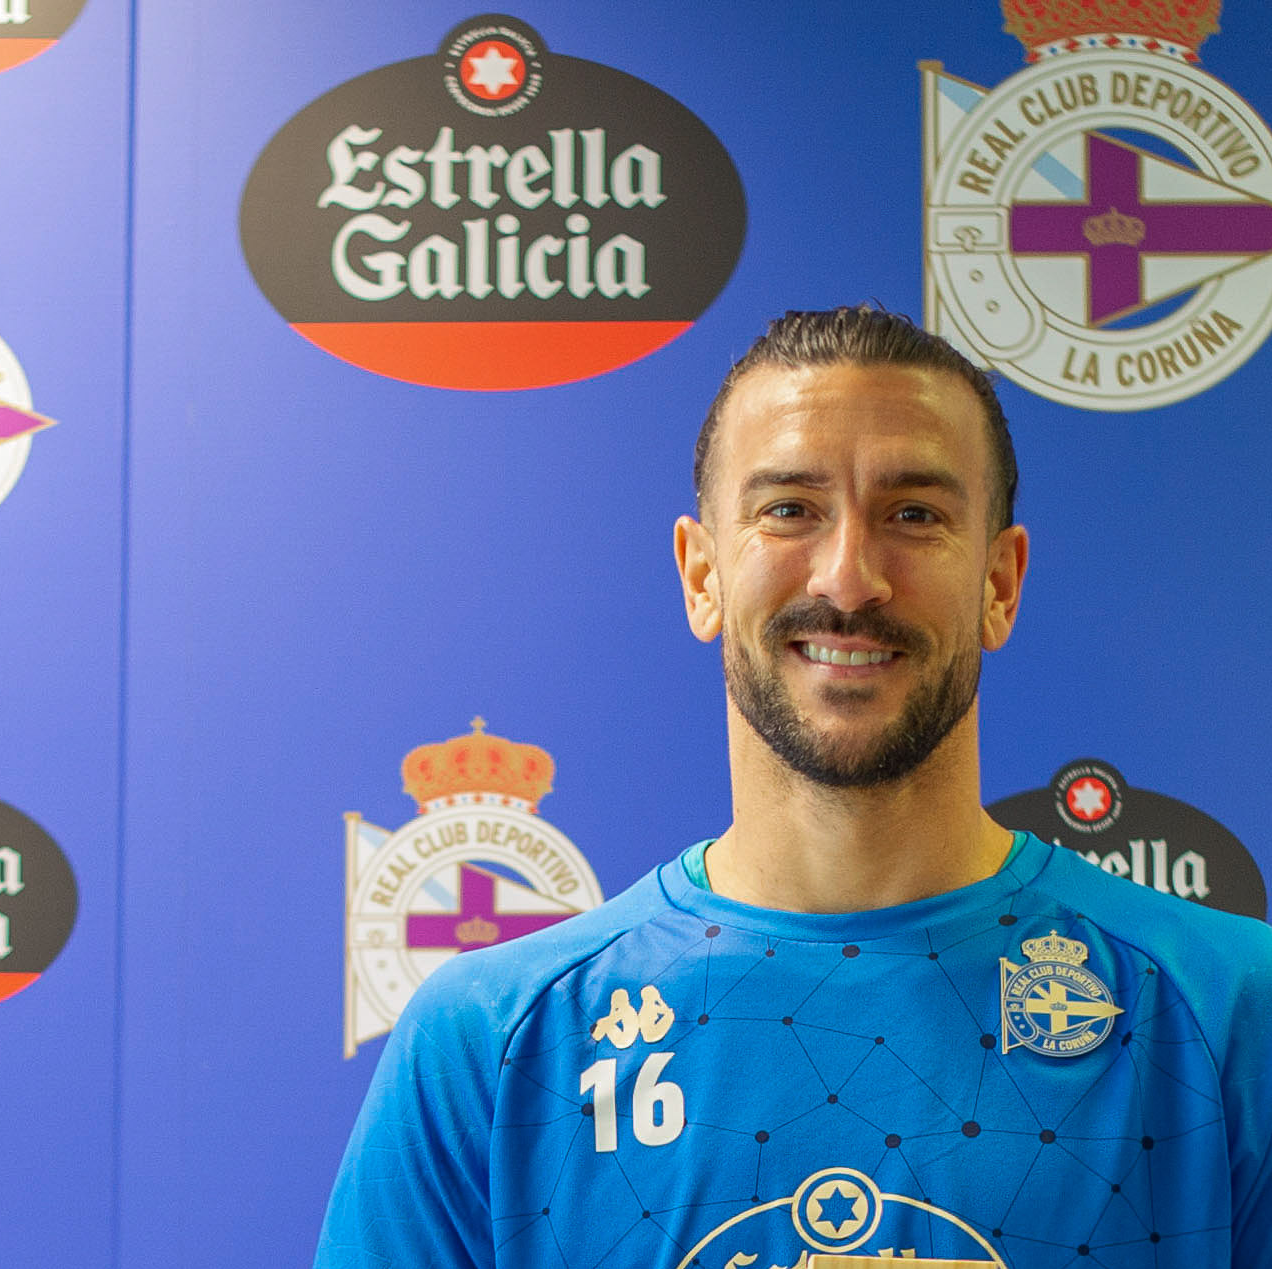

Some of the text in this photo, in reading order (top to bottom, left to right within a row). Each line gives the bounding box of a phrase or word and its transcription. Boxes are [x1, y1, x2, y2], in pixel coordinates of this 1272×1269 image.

[317, 124, 667, 211] Estrella
[959, 70, 1262, 196] REAL CLUB DEPORTIVO
[331, 213, 651, 301] Galicia
[1061, 309, 1244, 388] LA CORUÑA
[371, 820, 578, 907] REAL CLUB DEPORTIVO
[1011, 965, 1102, 997] REAL CLUB DEPORTIVO
[1043, 1039, 1055, 1050] LA
[580, 1052, 685, 1152] 16
